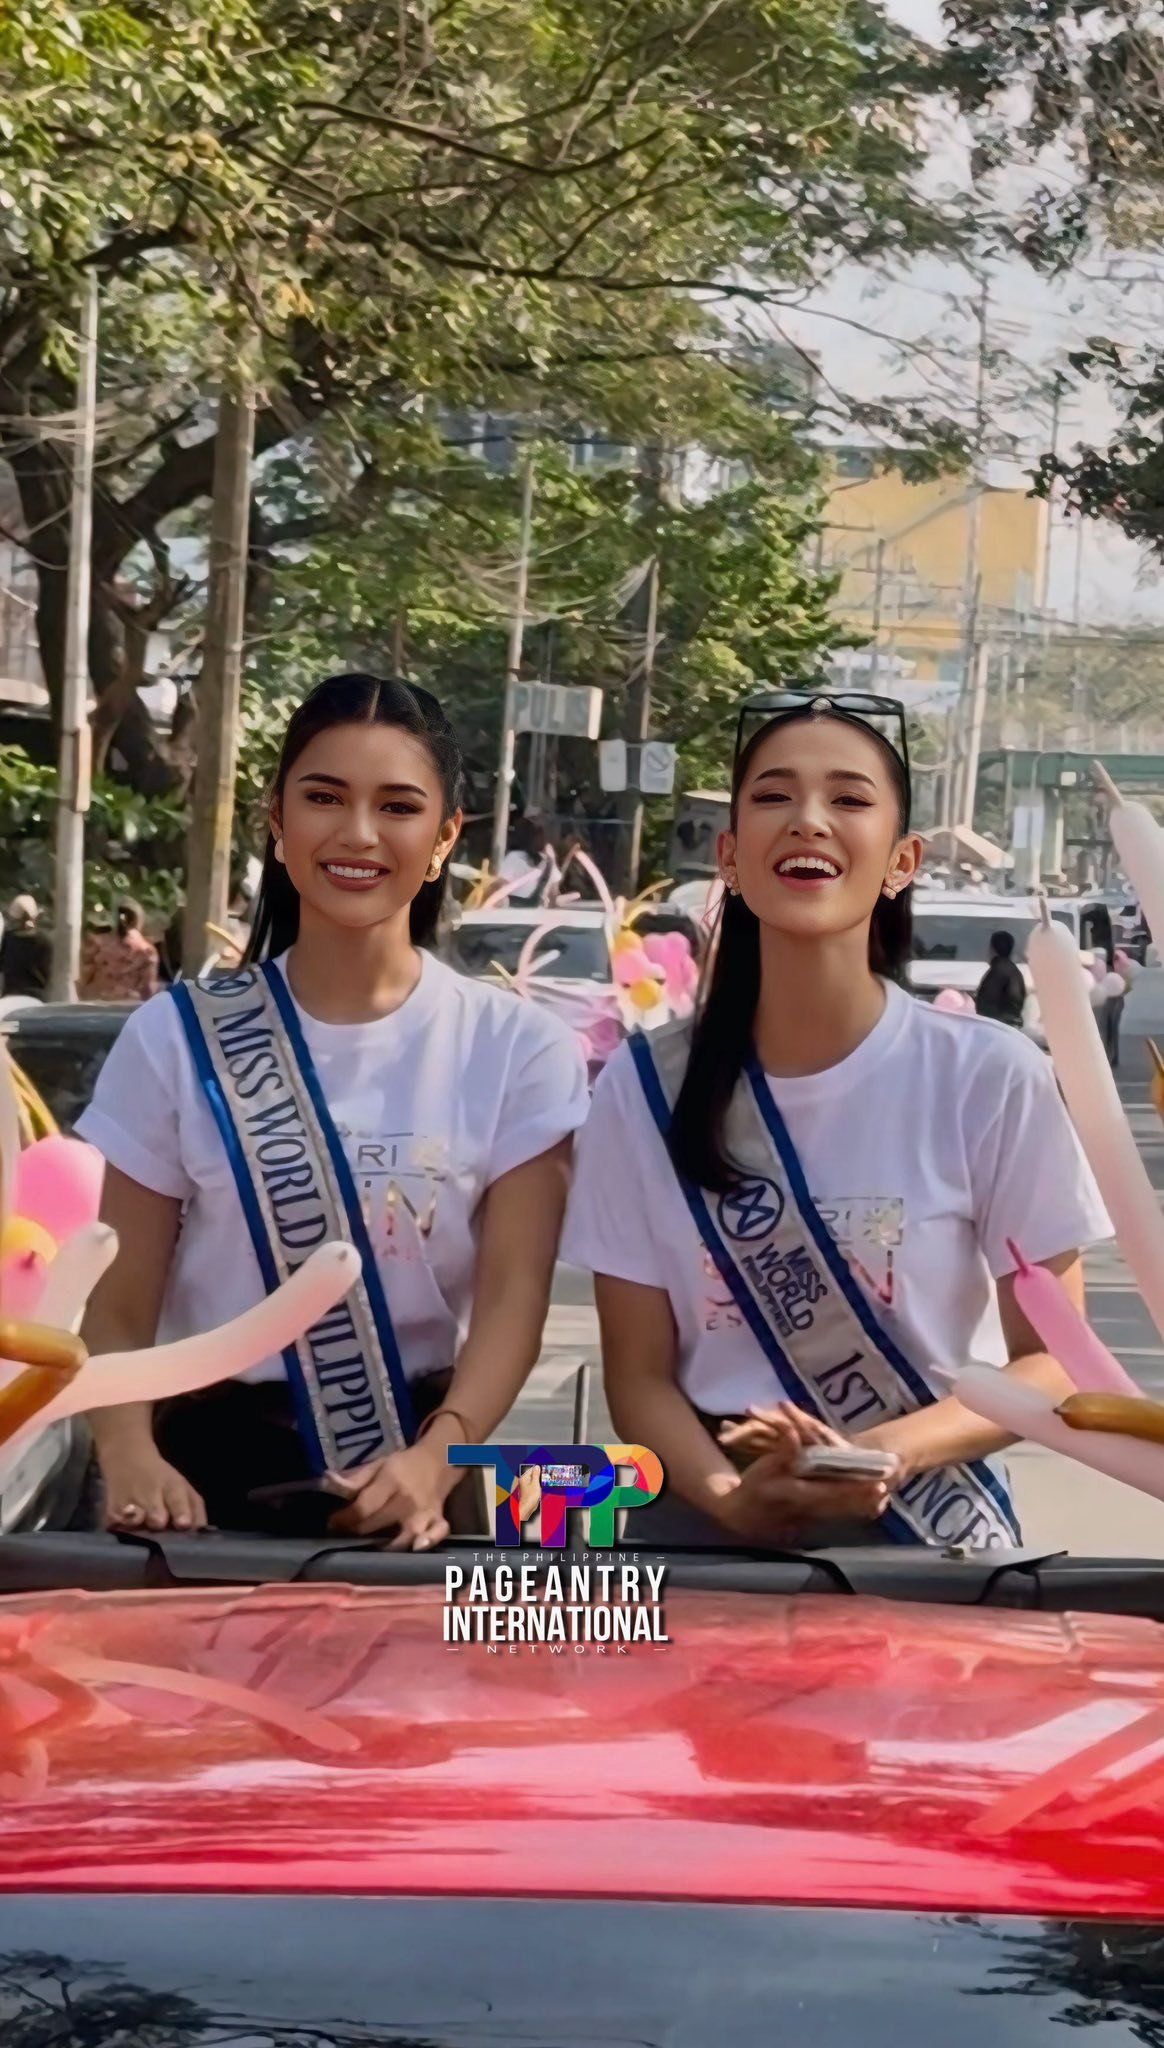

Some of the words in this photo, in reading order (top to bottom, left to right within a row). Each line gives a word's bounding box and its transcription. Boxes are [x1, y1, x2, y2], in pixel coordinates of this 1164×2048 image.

[212, 1005, 284, 1099] MISS
[245, 1096, 328, 1249] WORLD
[755, 1242, 815, 1331] WORLD
[781, 1245, 828, 1304] MISS
[287, 1261, 385, 1471] ILIPPIN
[814, 1351, 887, 1423] 1ST
